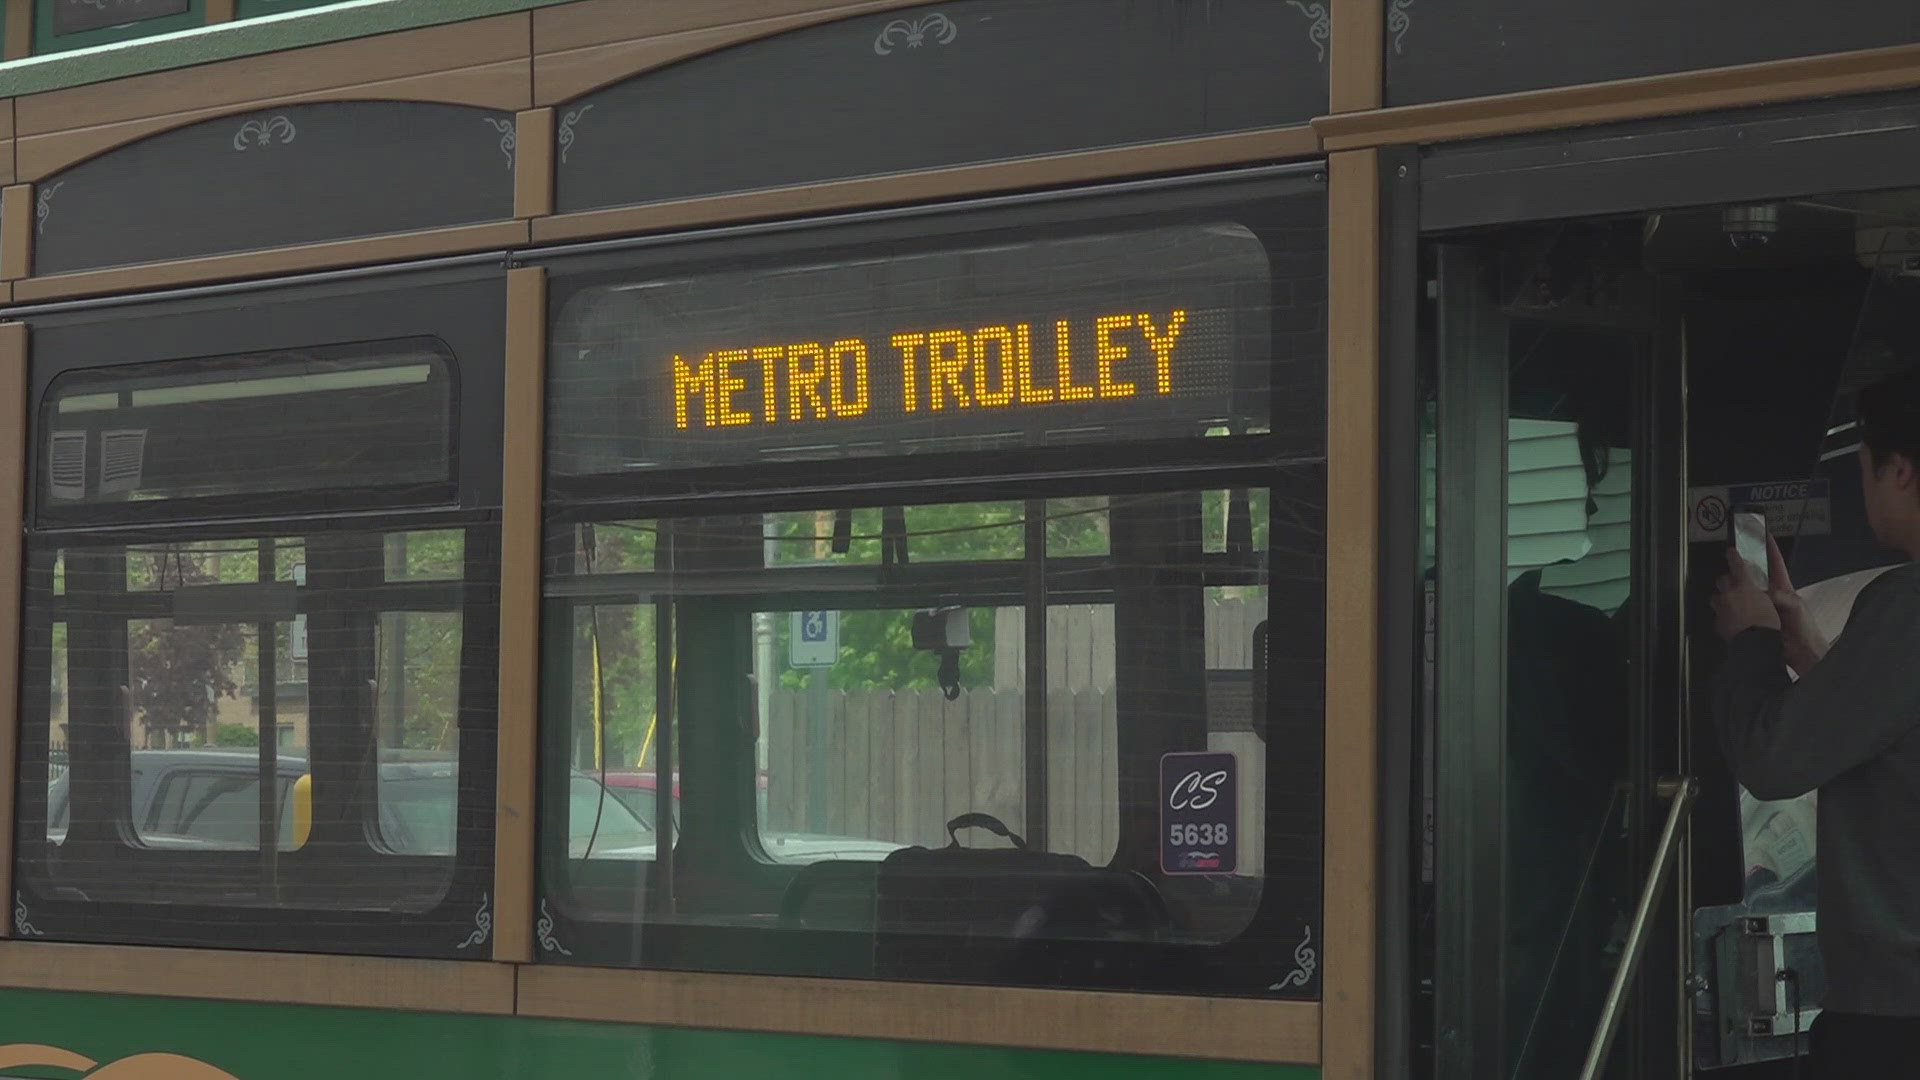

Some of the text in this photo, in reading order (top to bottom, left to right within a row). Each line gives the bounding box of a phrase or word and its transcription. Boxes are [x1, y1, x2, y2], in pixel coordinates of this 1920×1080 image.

[673, 309, 1187, 430] METRO TROLLEY
[1750, 484, 1808, 501] NOTICE
[1169, 771, 1227, 810] CS
[1169, 823, 1229, 846] 5638
